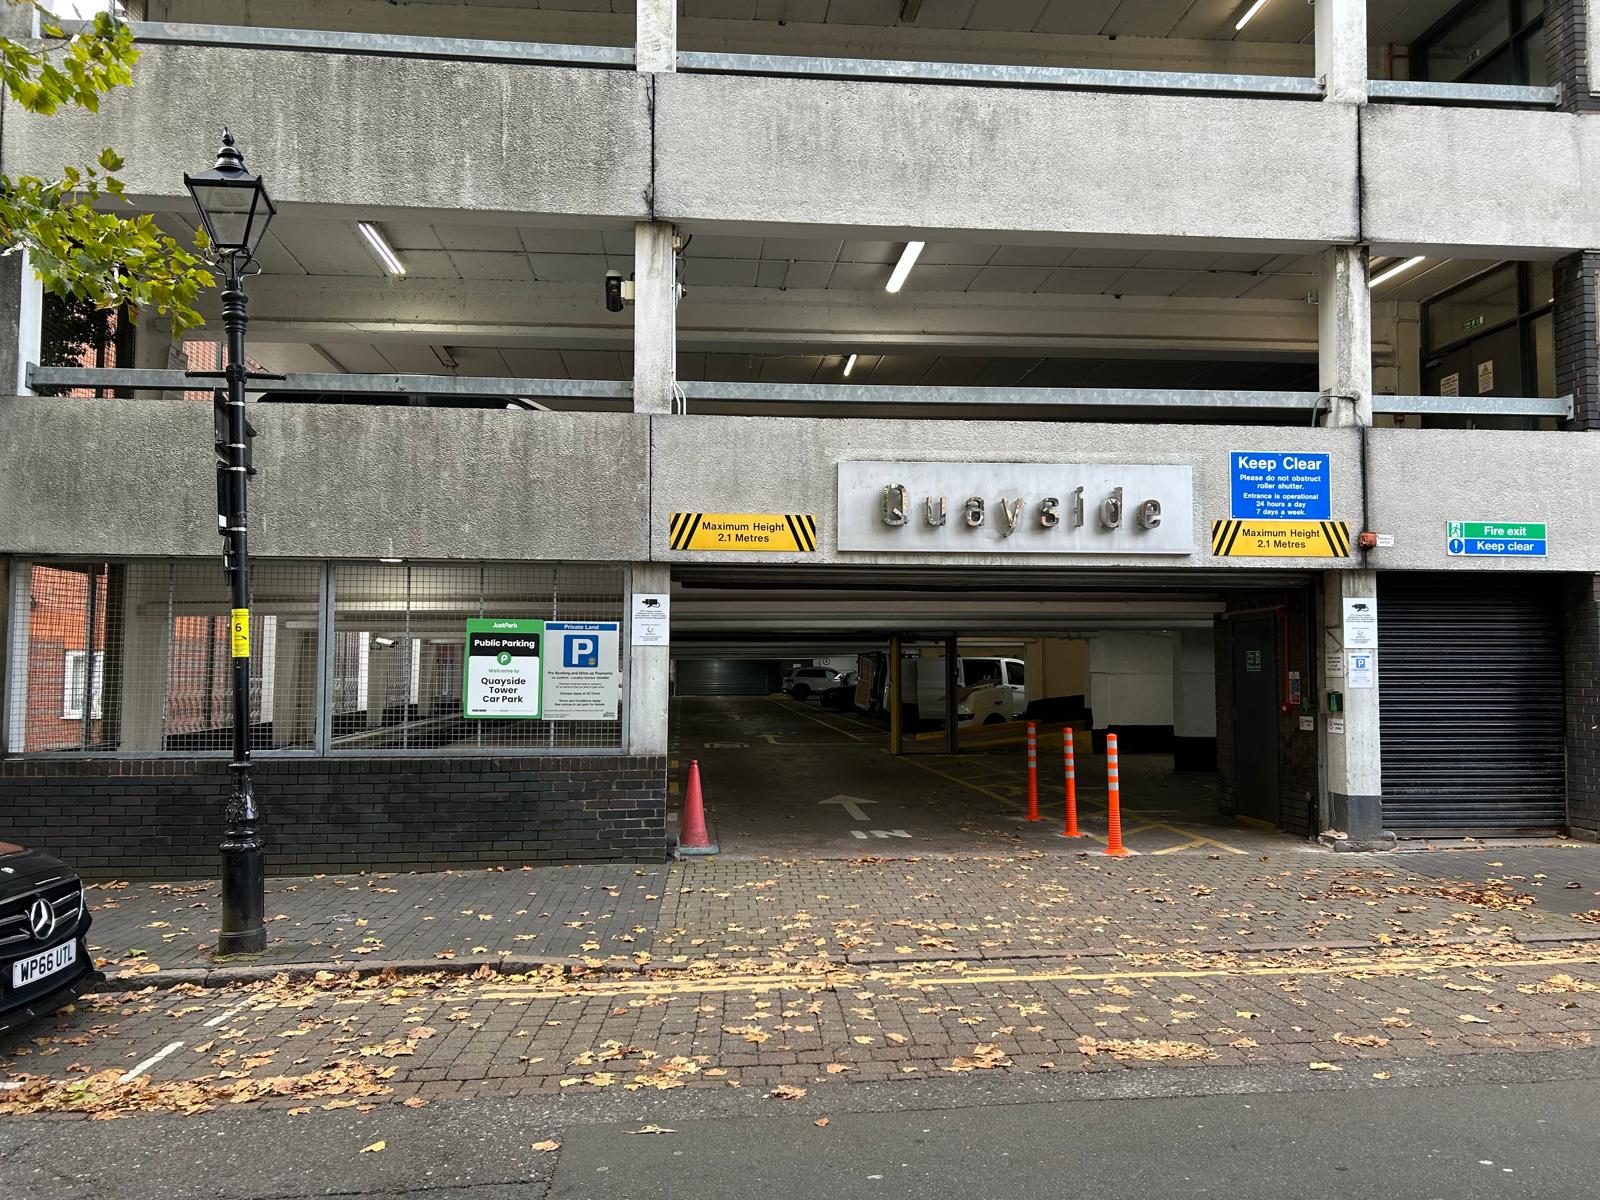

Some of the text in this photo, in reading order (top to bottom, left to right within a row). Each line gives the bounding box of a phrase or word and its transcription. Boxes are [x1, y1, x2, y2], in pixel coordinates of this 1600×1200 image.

[1238, 456, 1322, 471] Keep Clear
[1278, 474, 1290, 482] not
[1282, 493, 1319, 501] operational
[1294, 501, 1306, 509] day
[880, 483, 1163, 538] Quayside
[702, 522, 785, 533] Maximum Height
[1484, 526, 1527, 536] Fire exit
[718, 533, 770, 542] 2.1 Metres
[1242, 529, 1320, 539] Maximum Height
[1257, 540, 1306, 548] 2.1 Metres
[1476, 540, 1535, 552] Keep clear
[235, 623, 242, 632] 6
[474, 639, 535, 650] Public Parking
[572, 638, 593, 665] P
[481, 677, 526, 687] Quayside
[489, 686, 518, 694] Tower
[482, 695, 523, 703] Car Park
[849, 830, 913, 839] IN
[21, 944, 73, 982] WP66 UTL
